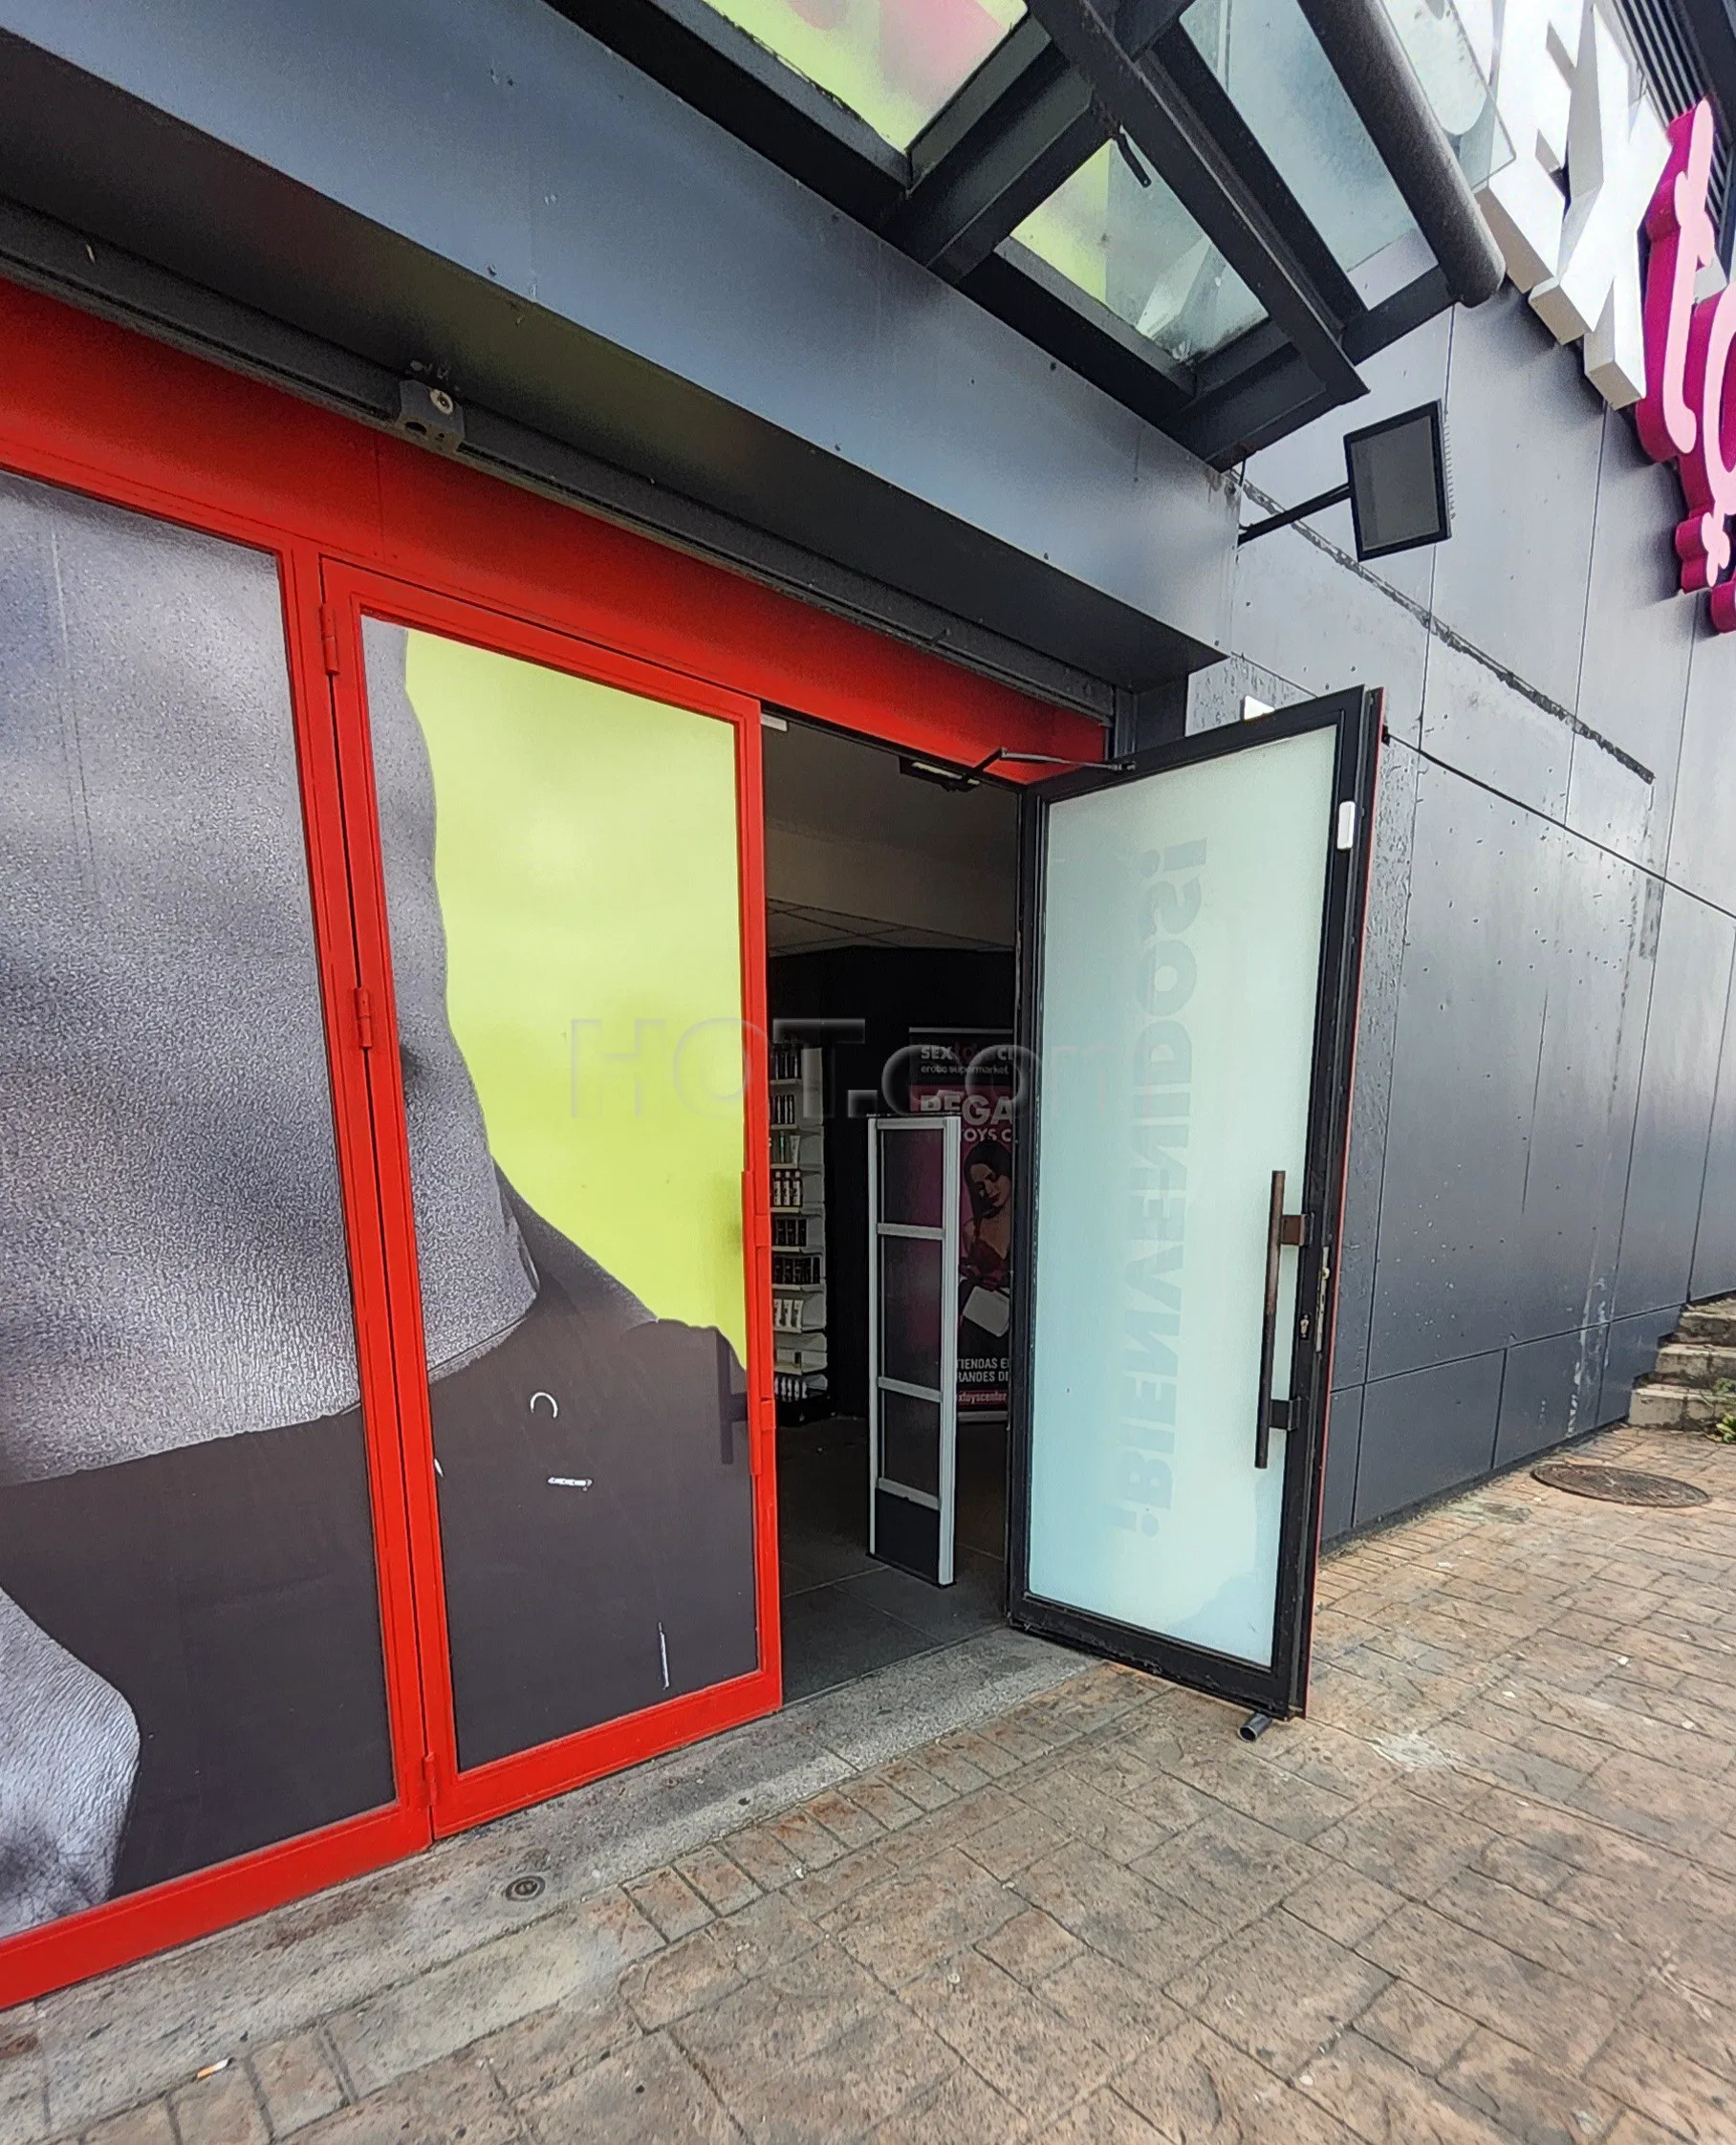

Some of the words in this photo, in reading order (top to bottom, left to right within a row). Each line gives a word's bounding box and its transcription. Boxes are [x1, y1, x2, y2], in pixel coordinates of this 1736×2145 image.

[921, 1046, 953, 1060] SEX
[962, 1128, 997, 1142] OYS
[1000, 1357, 1009, 1370] E
